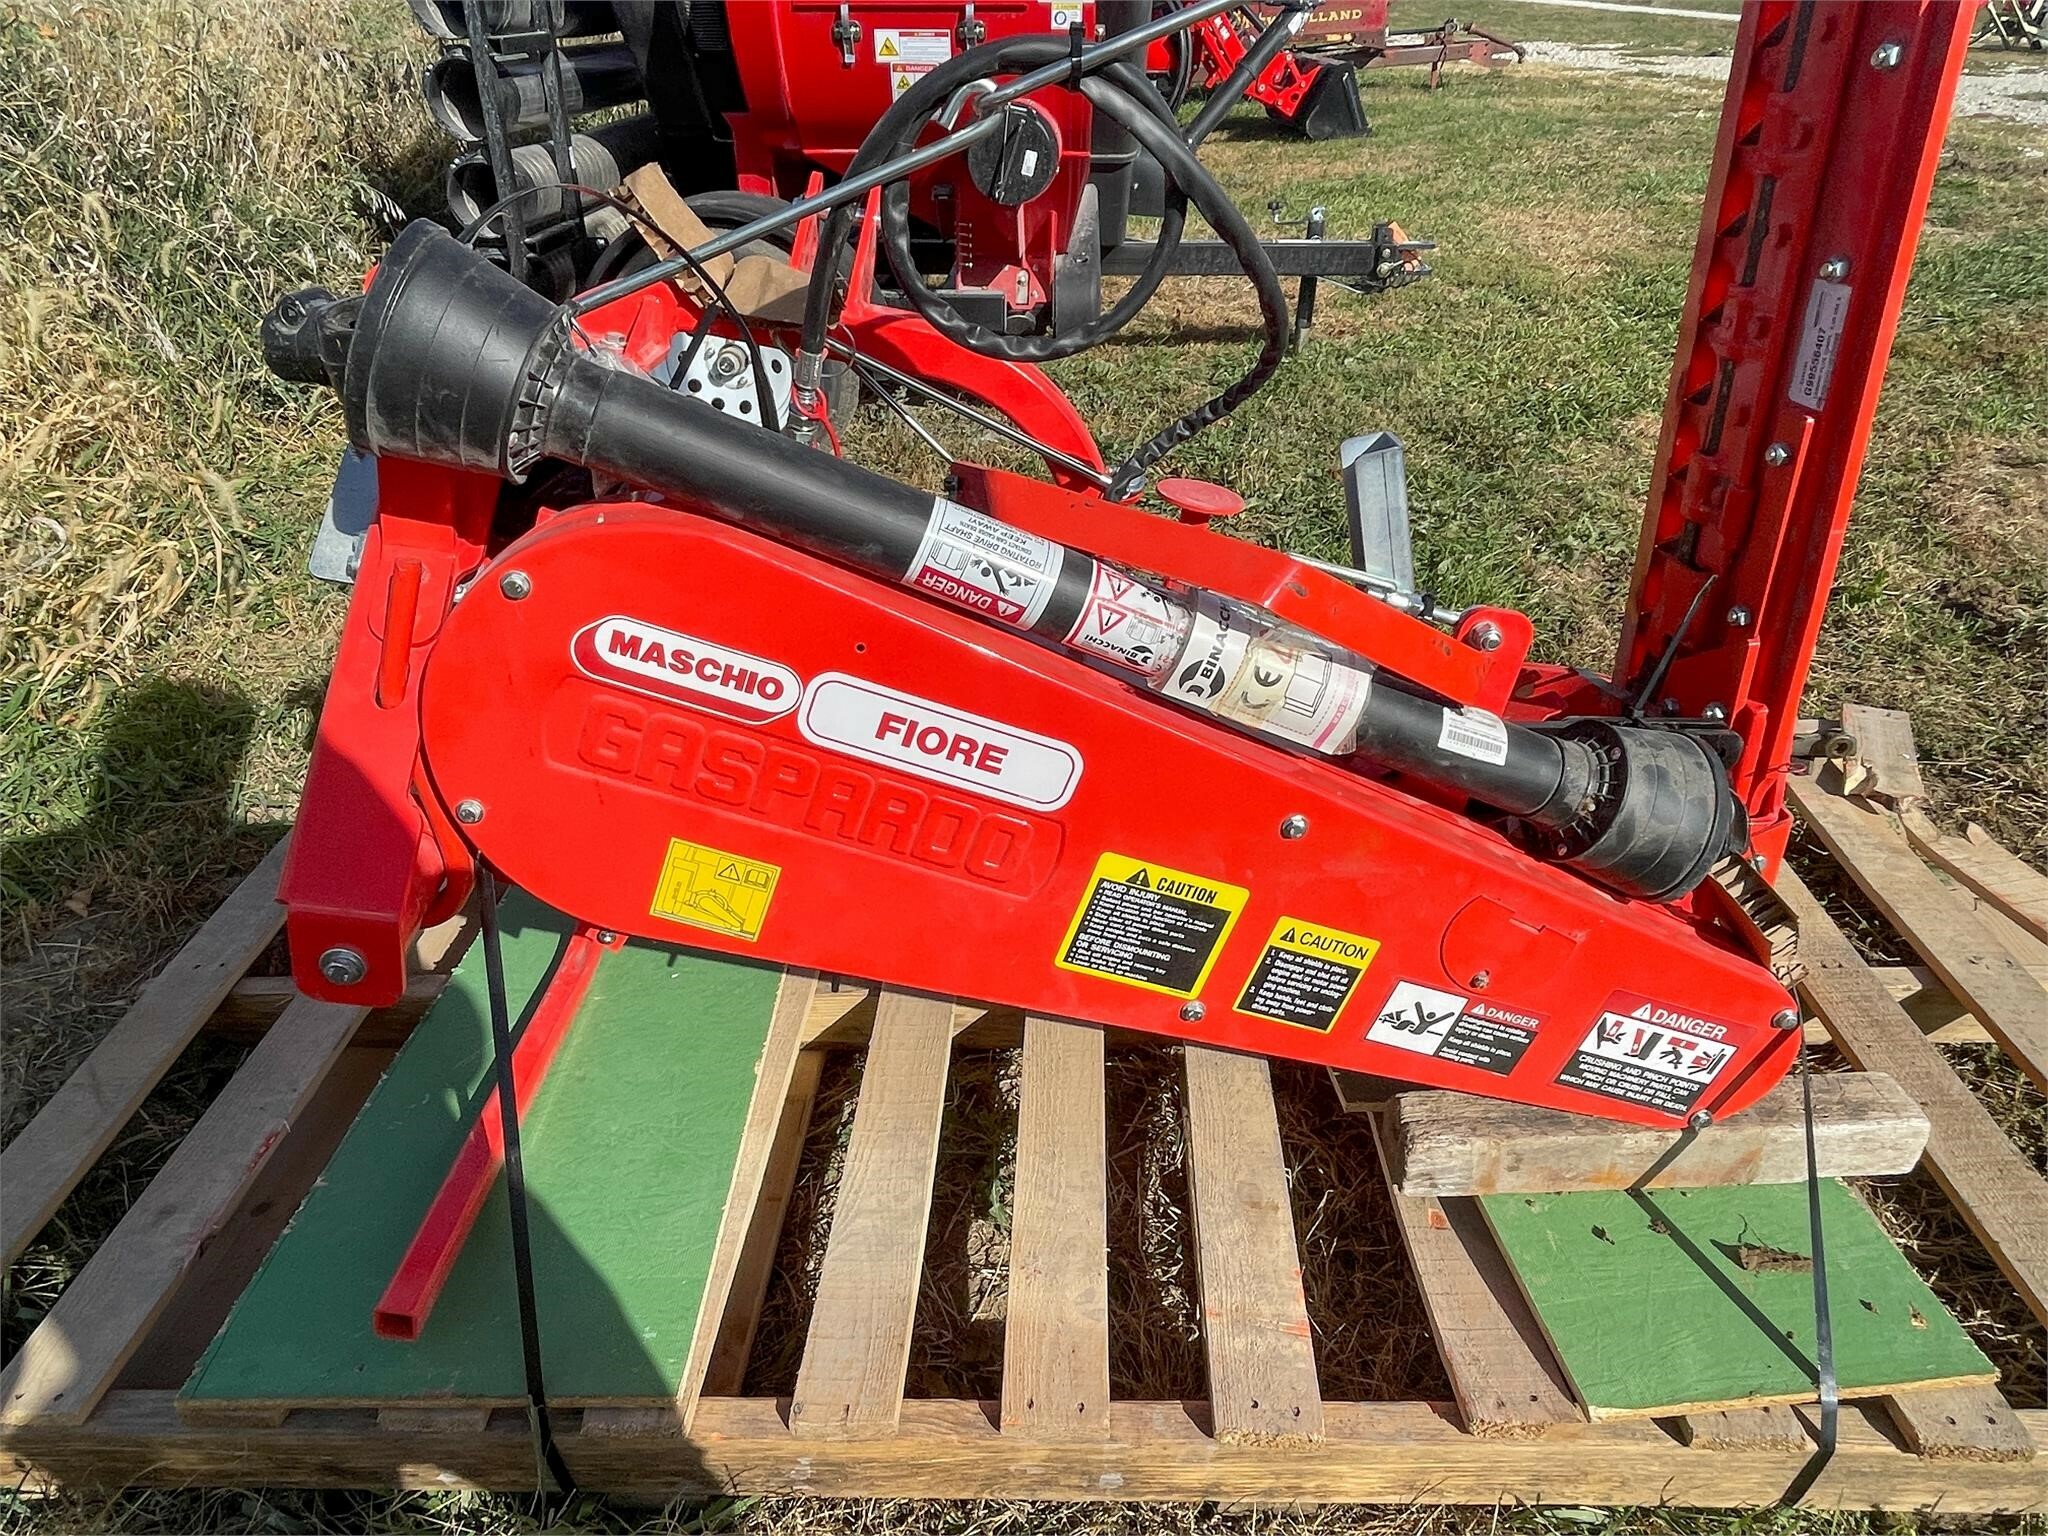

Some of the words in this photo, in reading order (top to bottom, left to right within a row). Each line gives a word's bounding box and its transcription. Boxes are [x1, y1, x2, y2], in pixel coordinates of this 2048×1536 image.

[1308, 9, 1363, 23] LLAND
[943, 523, 972, 540] SHAFT
[973, 535, 999, 551] DRIVE
[1001, 530, 1026, 544] KEEP
[1000, 546, 1041, 568] ROTATING
[922, 570, 992, 609] DANGER
[1084, 634, 1138, 658] BINACCHI
[1200, 600, 1231, 680] BINACCH
[608, 629, 784, 701] MASCHIO
[875, 711, 1009, 775] FIORE
[578, 694, 1034, 883] GASPARDO
[1100, 881, 1127, 892] AVOID
[1128, 888, 1160, 901] INJURY
[1156, 877, 1218, 903] CAUTION
[1078, 933, 1111, 945] BEFORE
[1113, 942, 1170, 960] DISMOUNTING
[1089, 944, 1133, 959] SERVICING
[1298, 931, 1368, 959] CAUTION
[1486, 1008, 1539, 1027] DANGER
[1650, 1008, 1729, 1039] DANGER
[1578, 1054, 1622, 1070] CRUSHING
[1622, 1066, 1642, 1075] AND
[1641, 1071, 1668, 1082] PINCH
[1667, 1079, 1699, 1091] POINTS
